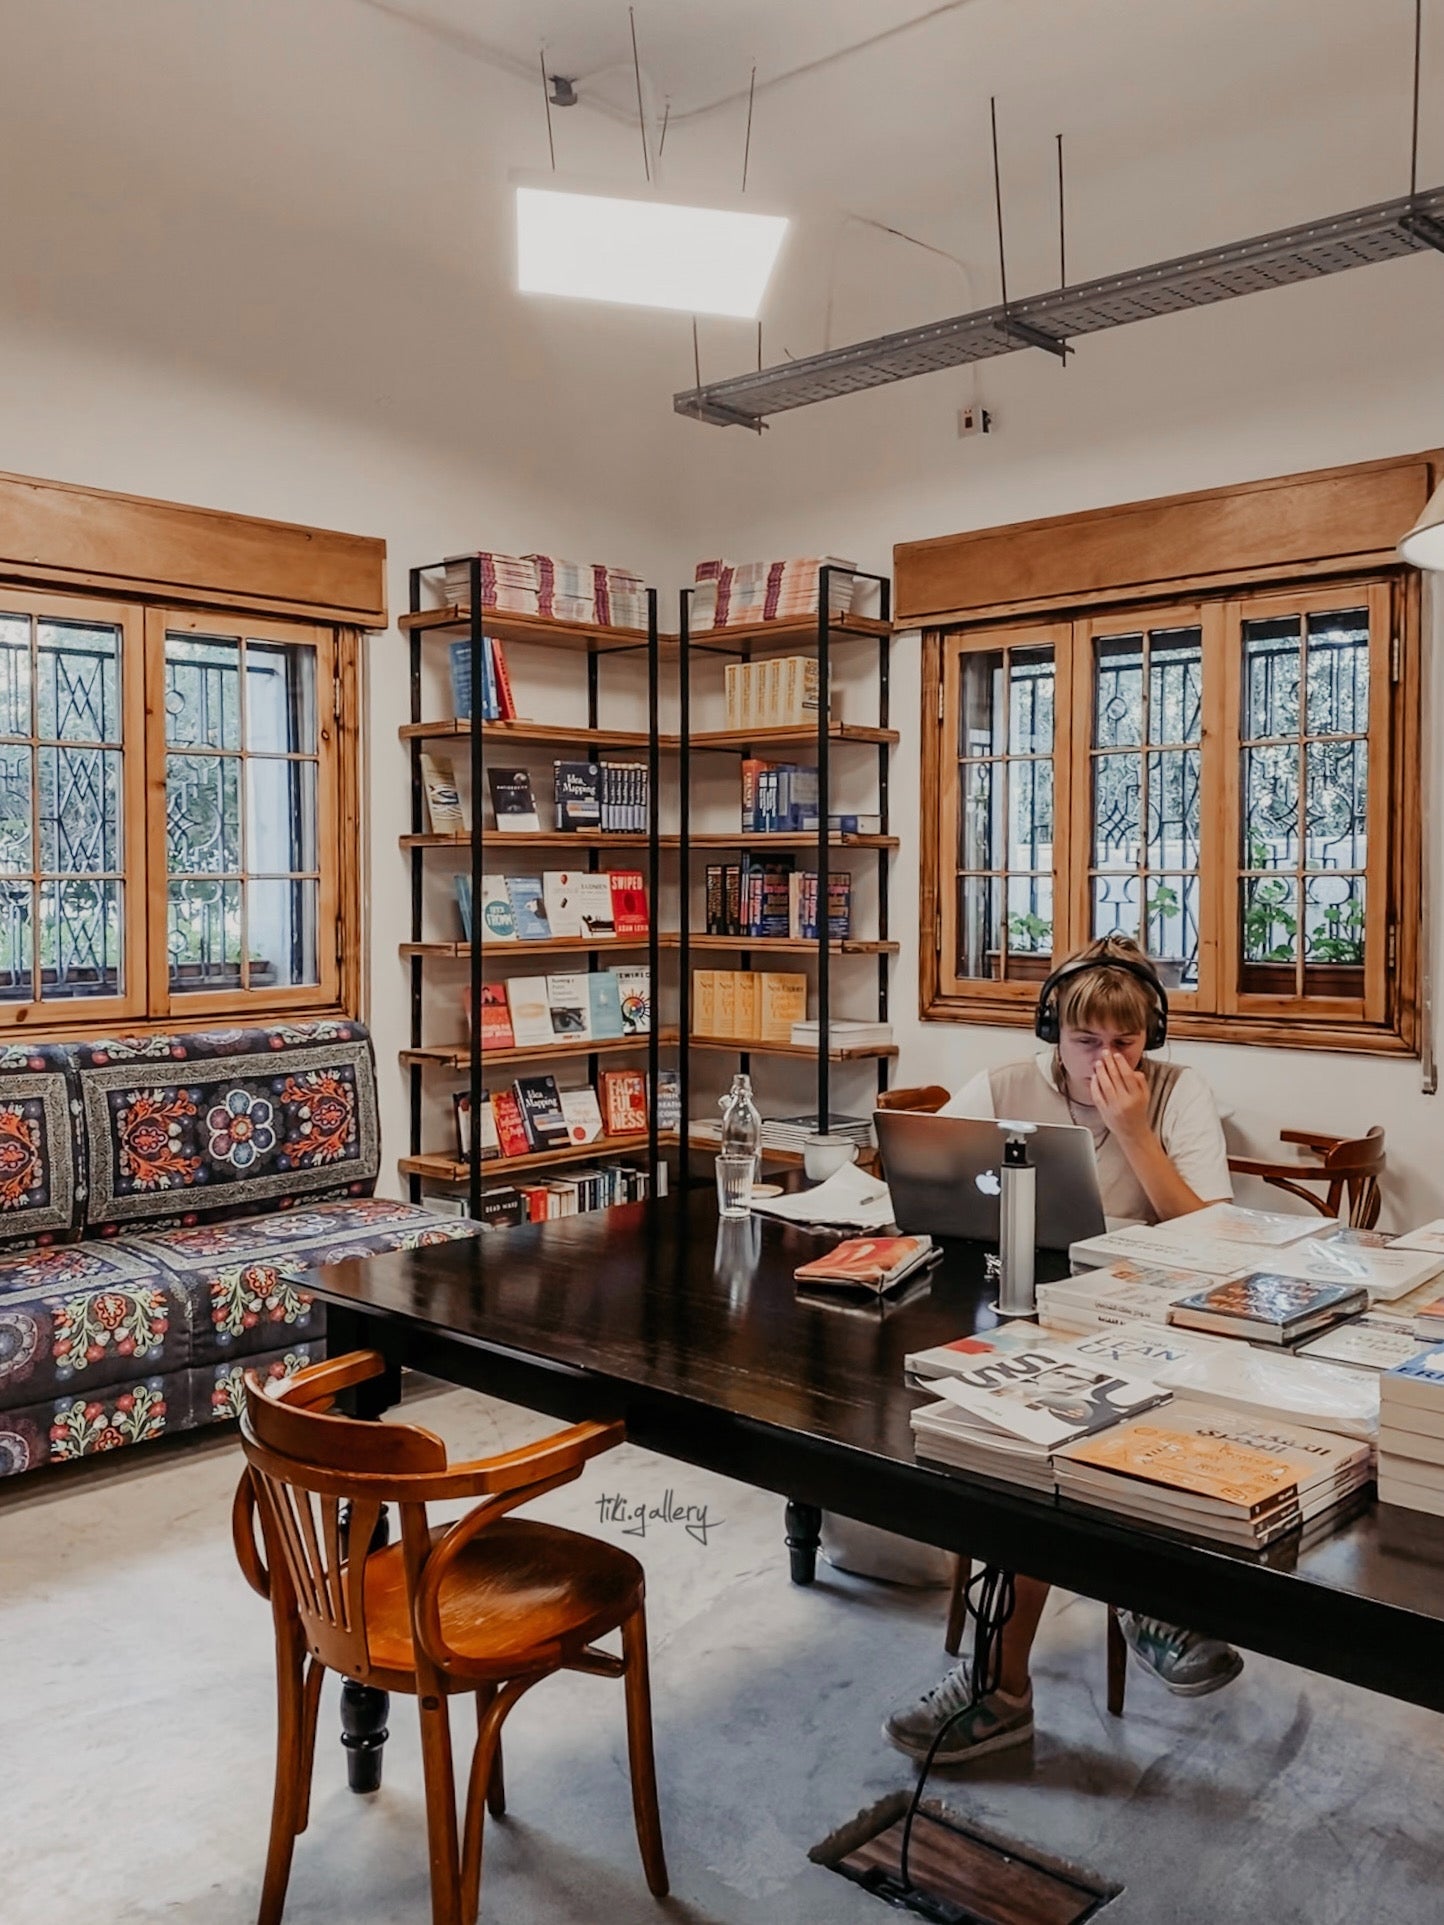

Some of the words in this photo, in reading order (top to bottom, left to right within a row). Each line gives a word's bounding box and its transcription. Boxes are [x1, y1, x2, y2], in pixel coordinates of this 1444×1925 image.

[566, 773, 587, 786] Idea
[563, 782, 596, 796] Mapping
[611, 875, 643, 891] SWIPED
[526, 1089, 544, 1099] Idea
[525, 1096, 559, 1109] Mapping
[611, 1094, 634, 1113] FUL
[612, 1110, 645, 1130] NESS
[1077, 1344, 1132, 1361] UX
[1094, 1337, 1188, 1360] LEAN
